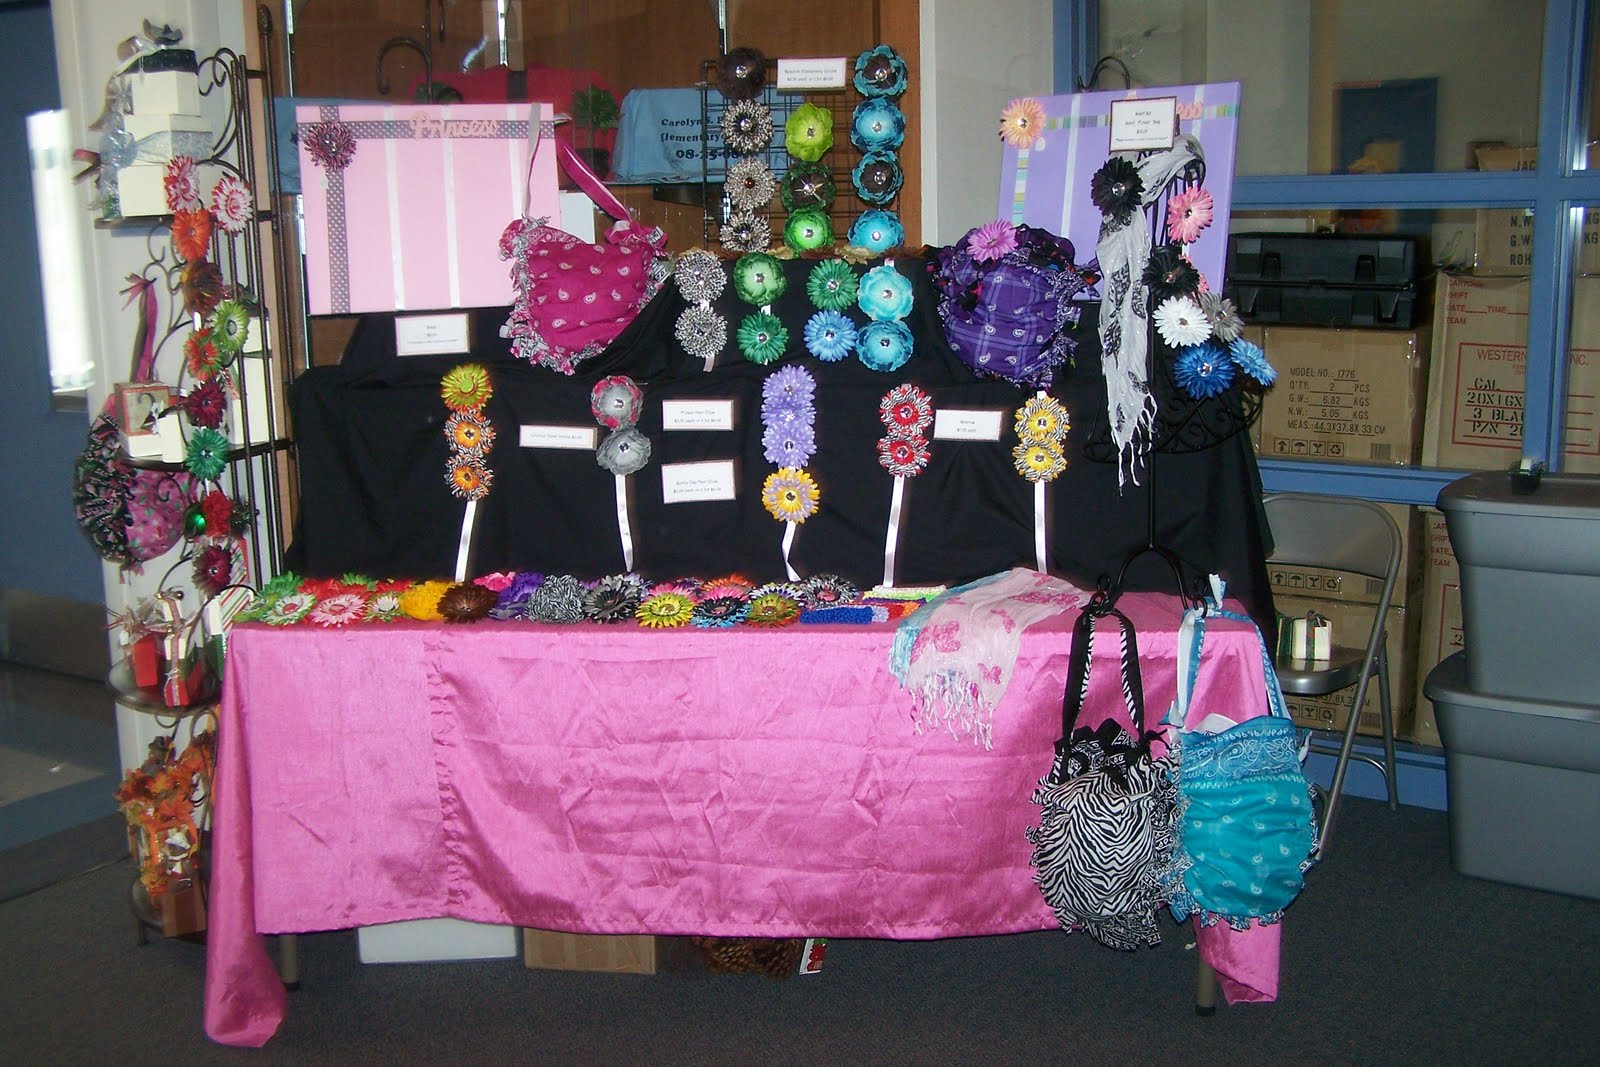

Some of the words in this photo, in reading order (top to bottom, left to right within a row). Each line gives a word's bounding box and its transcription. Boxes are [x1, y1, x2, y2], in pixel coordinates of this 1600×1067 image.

[409, 111, 498, 140] Princess
[661, 117, 702, 127] Carolyn
[1487, 305, 1507, 313] TIME
[1478, 349, 1526, 362] WESTERN
[1570, 354, 1589, 366] NC.
[1290, 367, 1315, 377] MODEL
[1329, 382, 1335, 391] 2
[1354, 384, 1370, 393] PCS
[1474, 377, 1500, 391] CAL
[1322, 395, 1340, 405] 6.82
[1353, 397, 1370, 407] KGS
[1321, 408, 1339, 418] 5.05
[1352, 410, 1369, 420] KGS
[1473, 407, 1482, 419] 3
